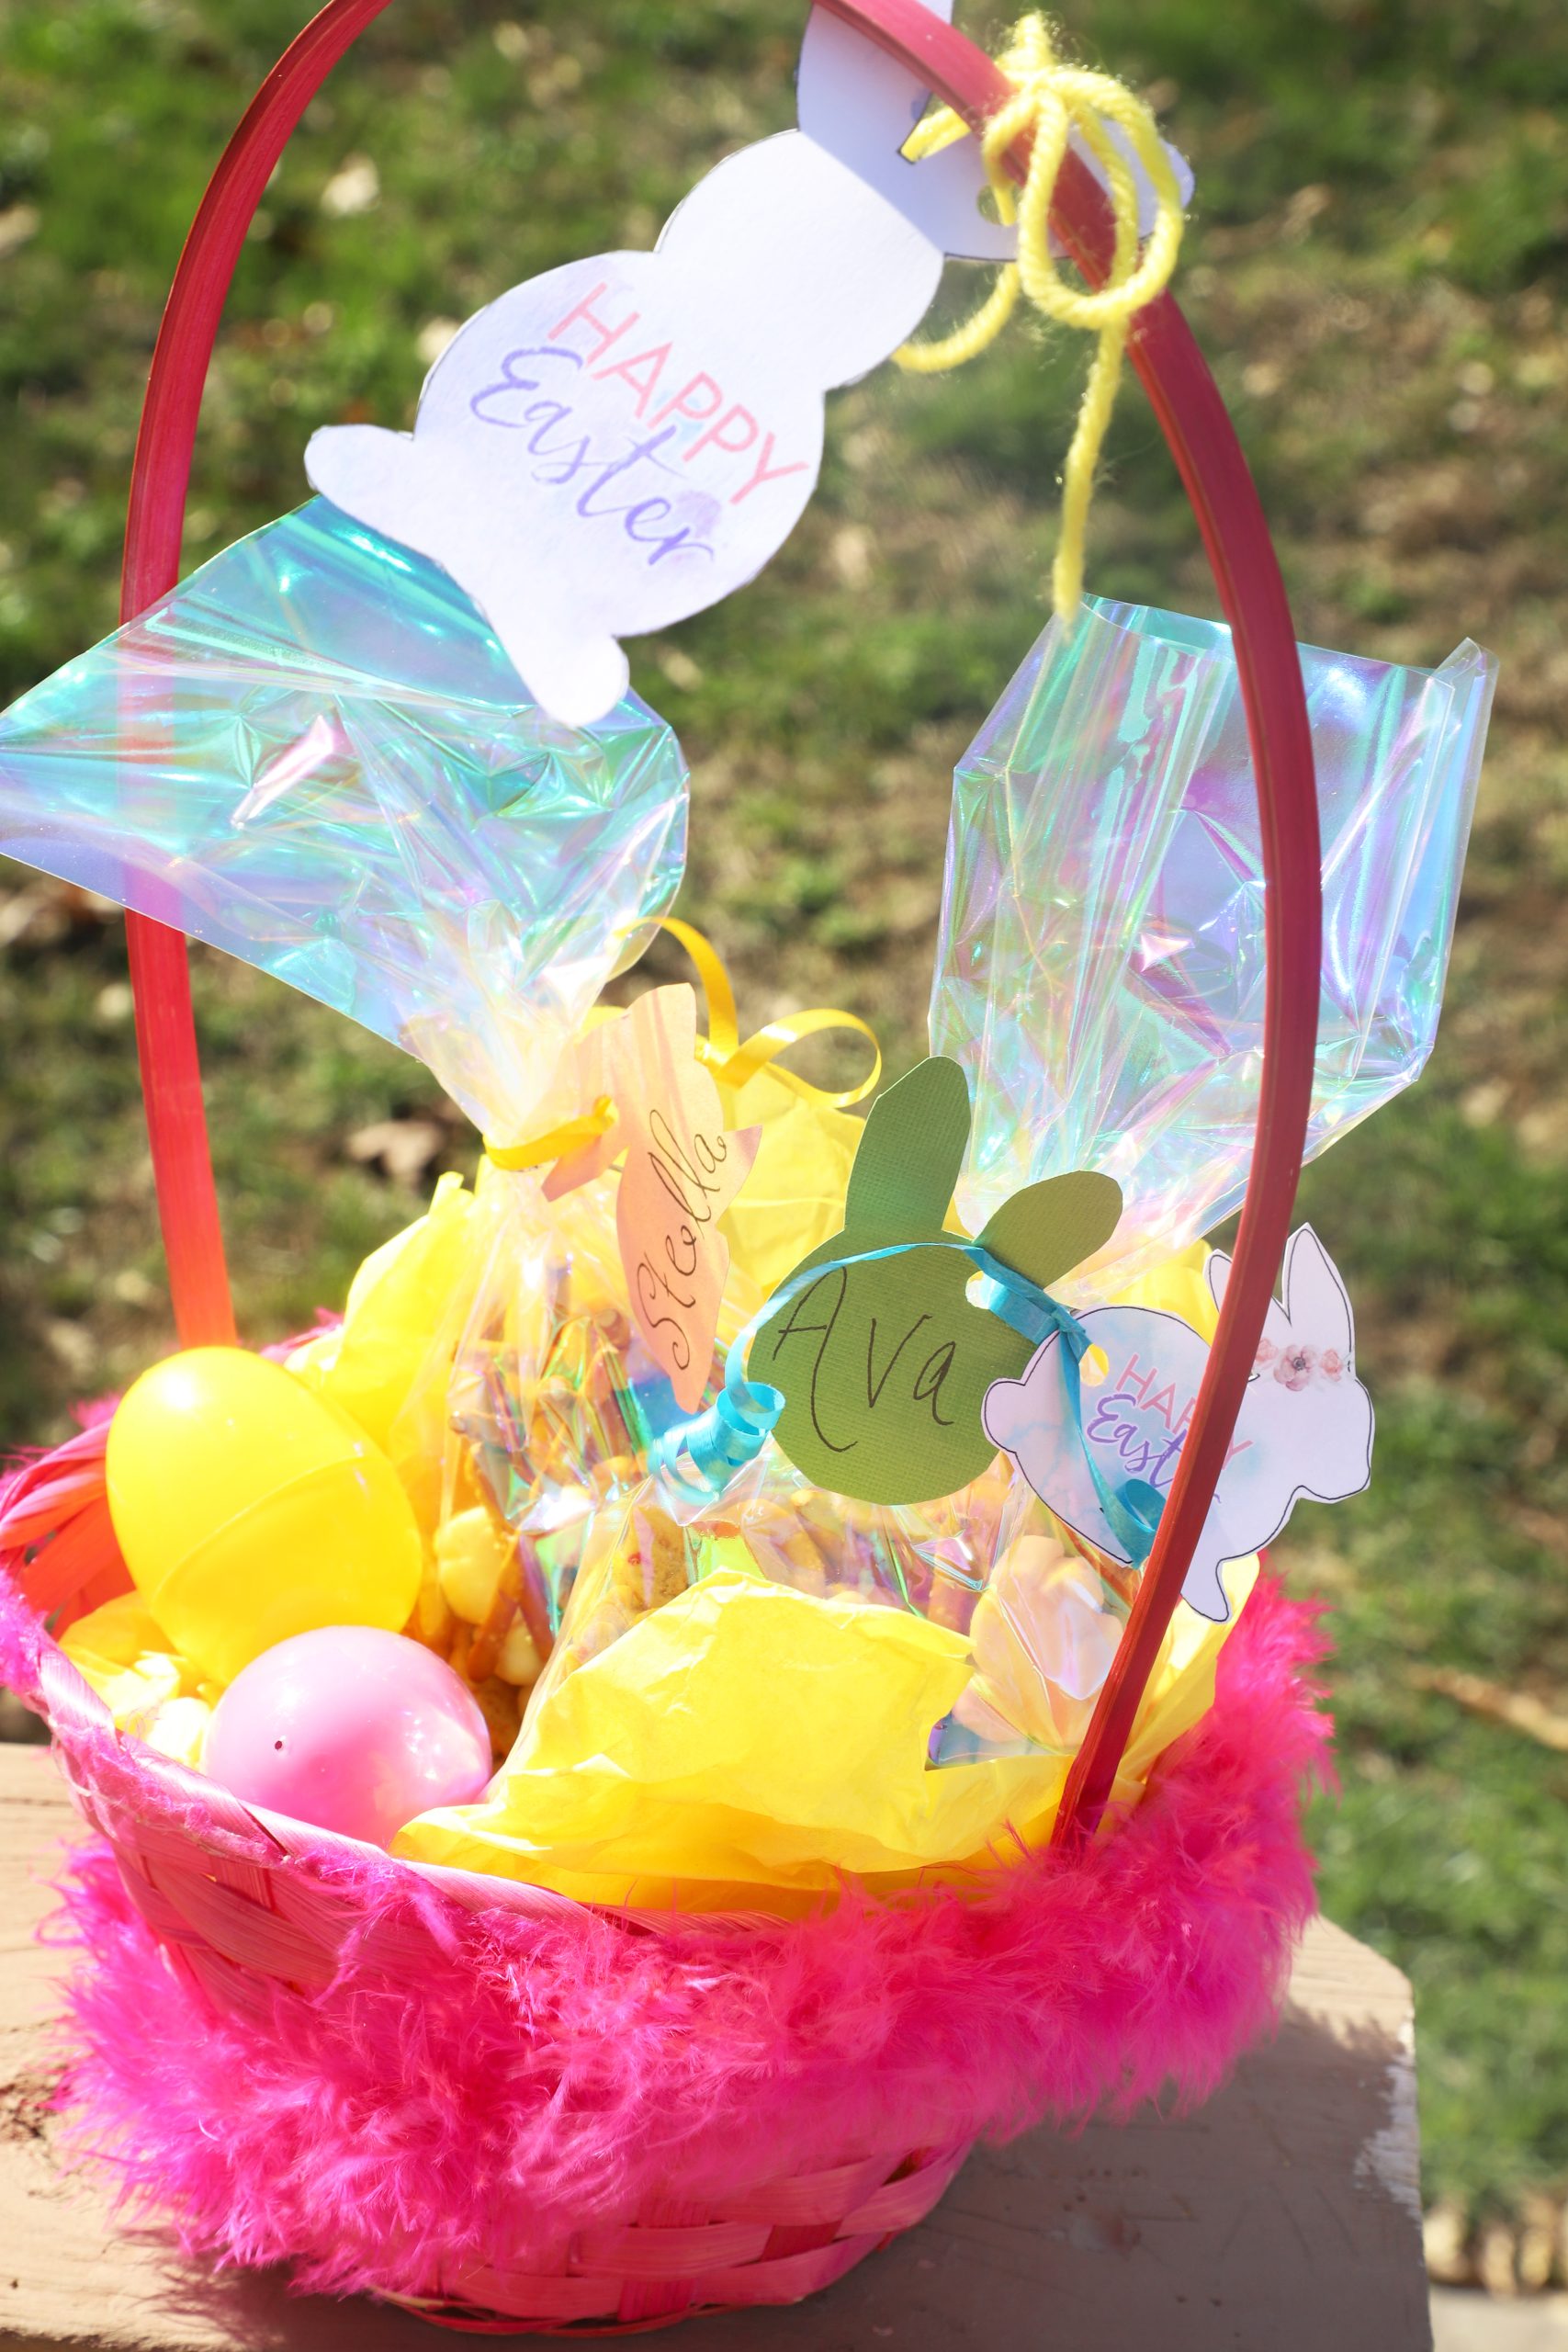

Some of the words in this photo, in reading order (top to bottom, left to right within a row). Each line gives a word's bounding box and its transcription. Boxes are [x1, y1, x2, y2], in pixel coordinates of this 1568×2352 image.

[469, 346, 715, 566] Easter
[547, 282, 810, 505] HAPPY
[636, 1109, 728, 1371] Stella
[773, 1265, 956, 1453] Ava
[1087, 1393, 1222, 1504] East
[1115, 1353, 1254, 1471] HAPY
